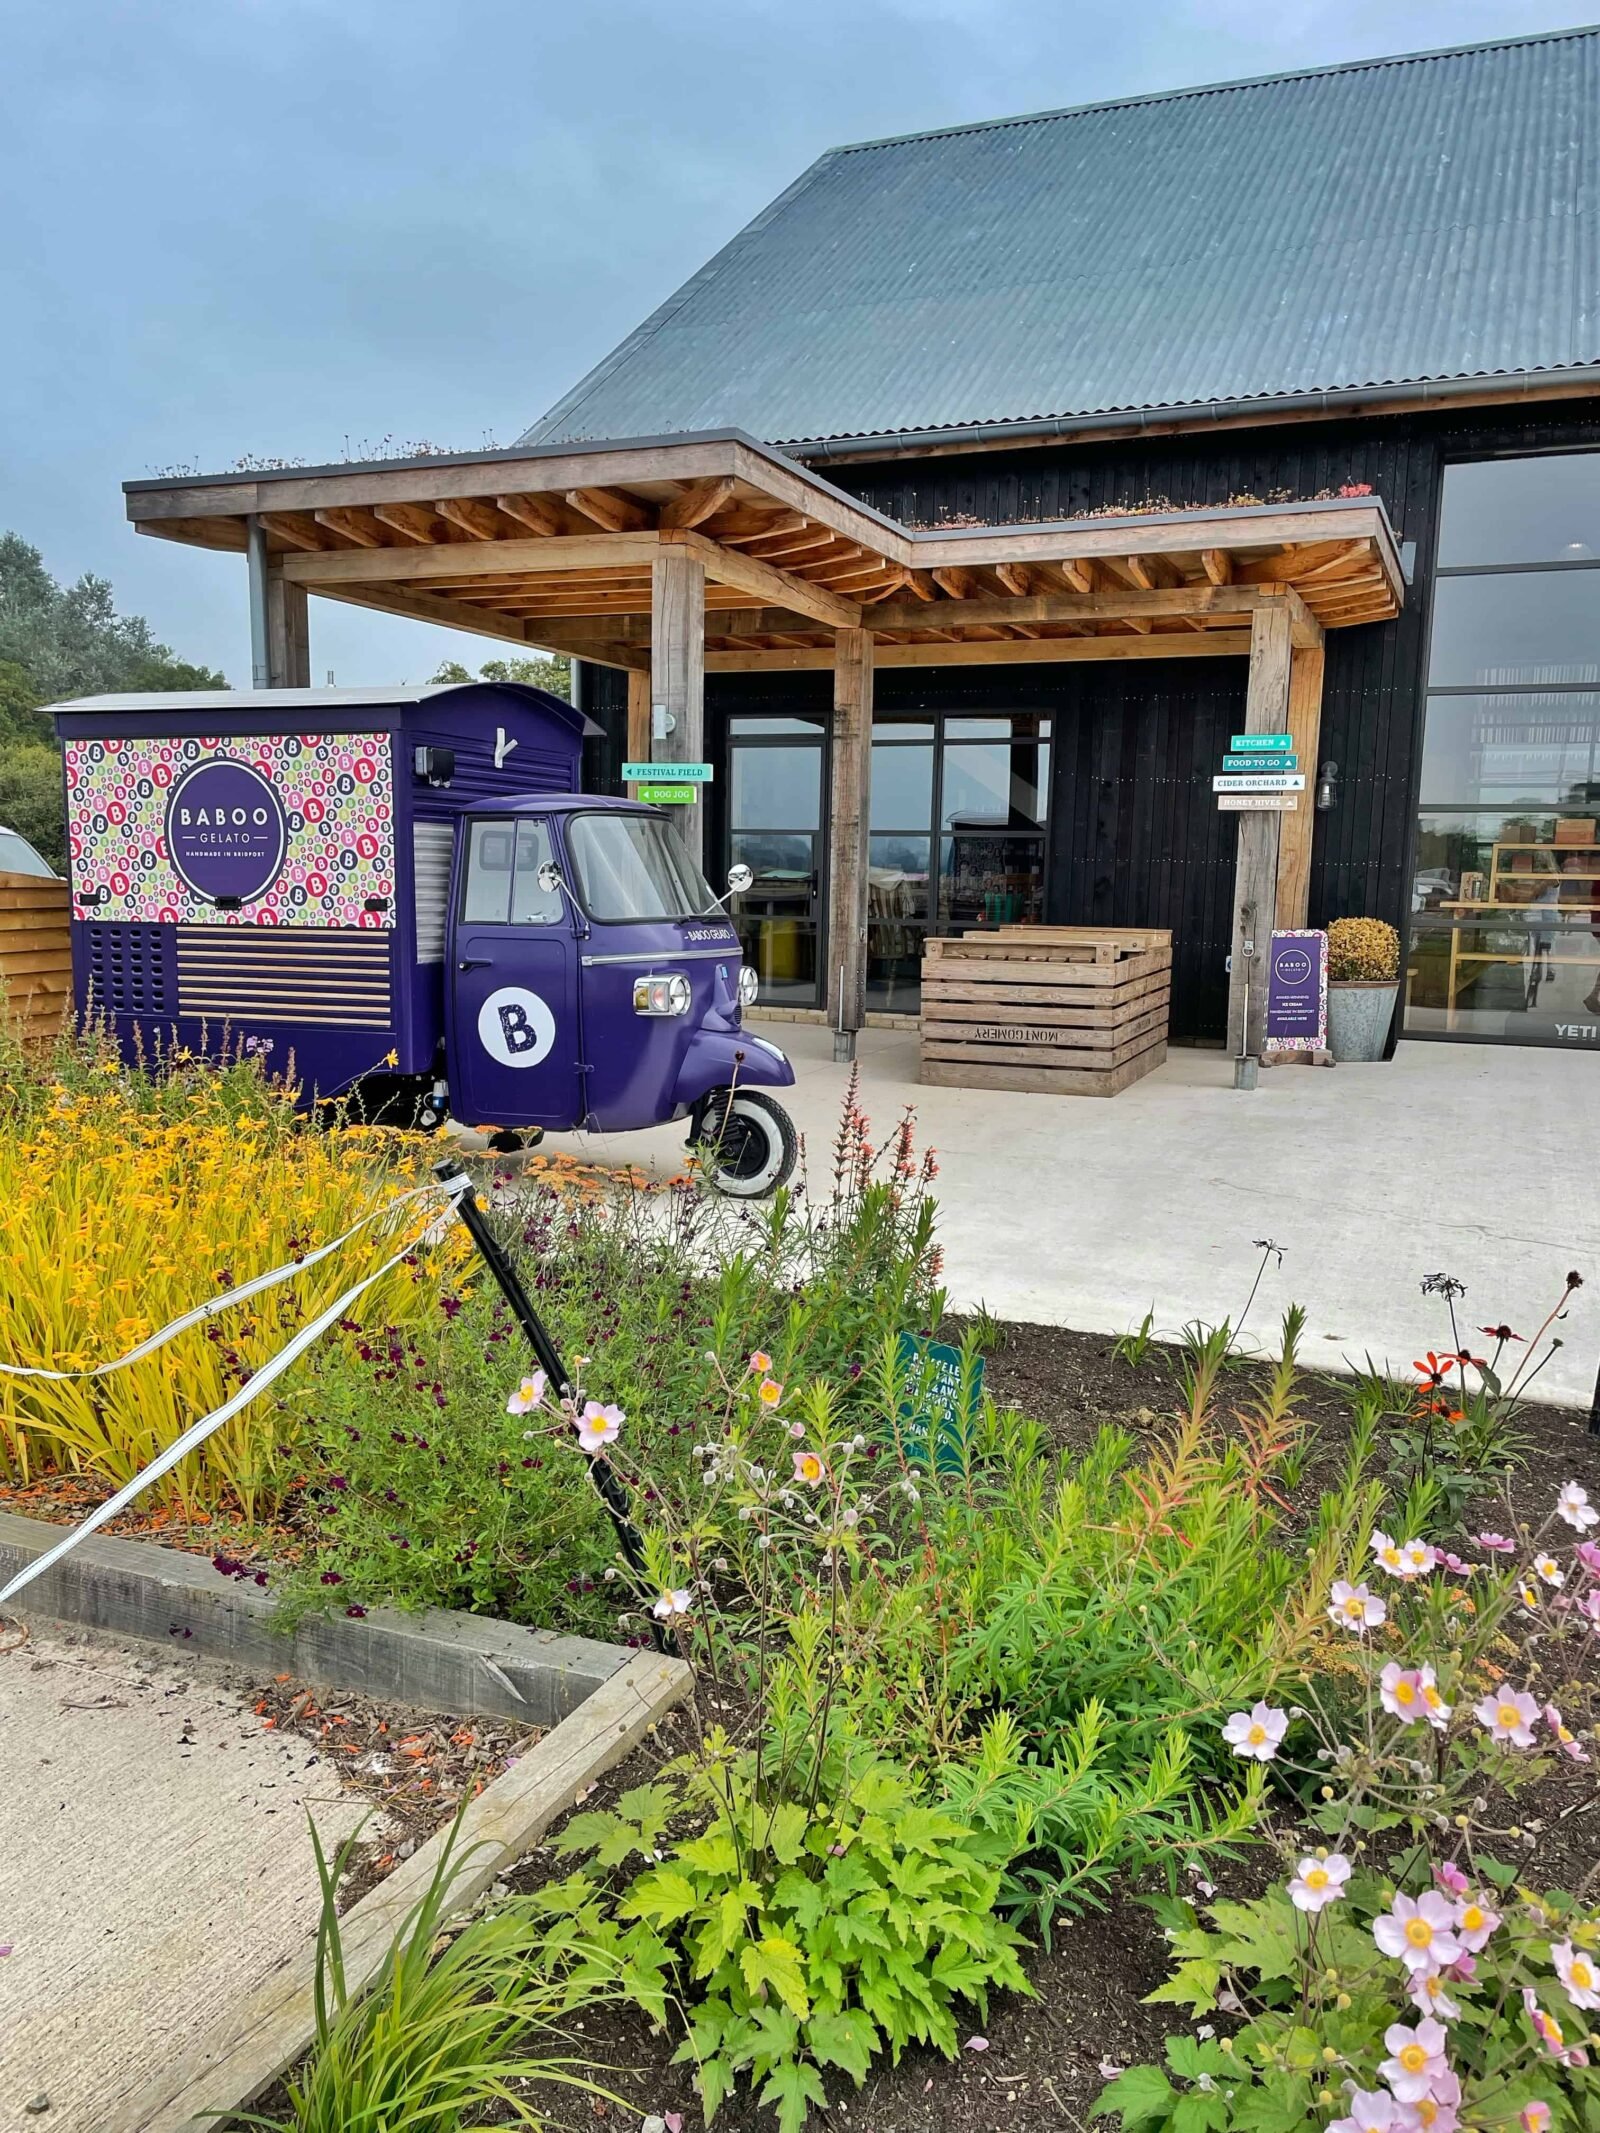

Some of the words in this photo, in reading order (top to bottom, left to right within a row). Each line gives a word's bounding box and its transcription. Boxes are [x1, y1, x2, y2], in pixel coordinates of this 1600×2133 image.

[1236, 739, 1274, 747] KITCHEN
[1228, 759, 1251, 767] FOOD
[637, 768, 676, 776] FESTIVAL
[678, 768, 703, 776] FIELD
[181, 808, 268, 826] BABOO
[200, 833, 250, 843] GELATO
[497, 1003, 537, 1054] B
[974, 1027, 1058, 1042] MONTGOMERY
[1554, 1023, 1597, 1038] YETI
